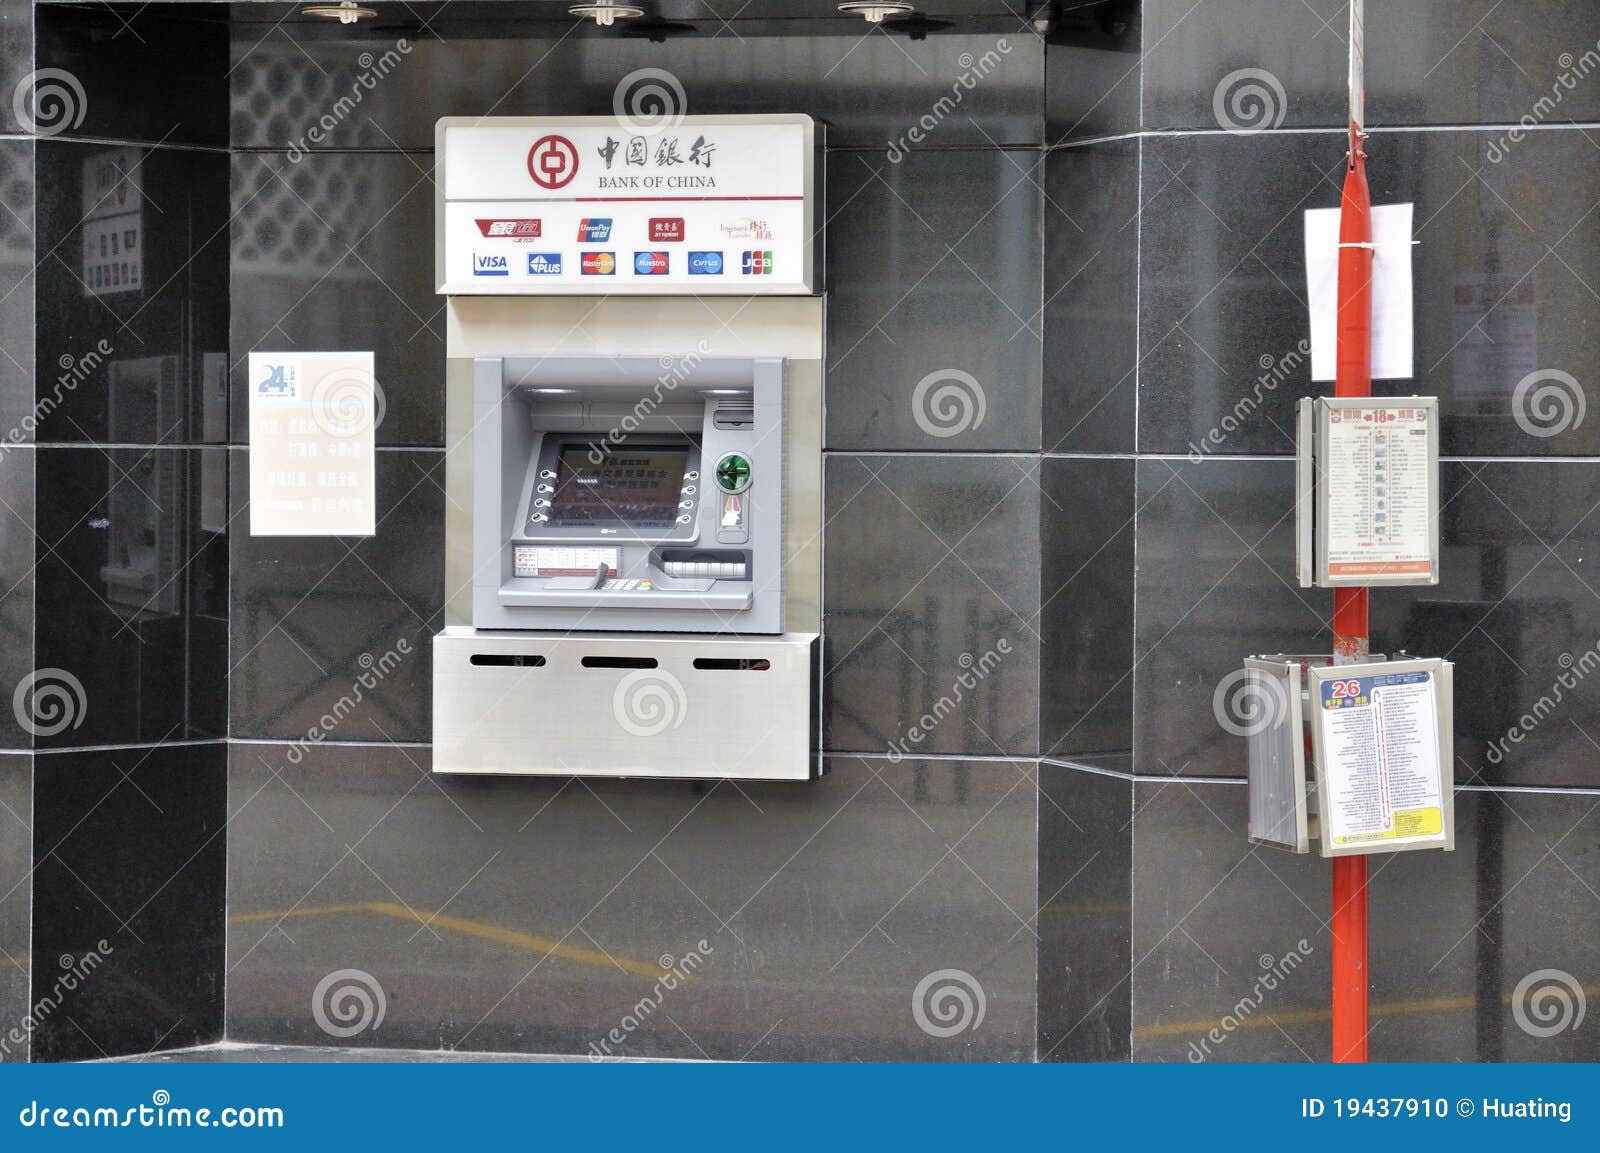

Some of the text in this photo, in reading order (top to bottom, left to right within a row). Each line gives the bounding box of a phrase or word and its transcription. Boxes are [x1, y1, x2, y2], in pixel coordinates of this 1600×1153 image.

[597, 135, 717, 169] 中國銀行
[599, 175, 717, 189] BANK OF CHINA
[580, 224, 610, 232] UnionPay
[478, 256, 507, 267] VISA
[693, 259, 718, 267] Cirrus
[742, 258, 772, 268] JCB
[537, 263, 561, 273] PLUS
[258, 364, 289, 393] 24
[1373, 409, 1387, 423] 18
[1332, 680, 1360, 698] 26
